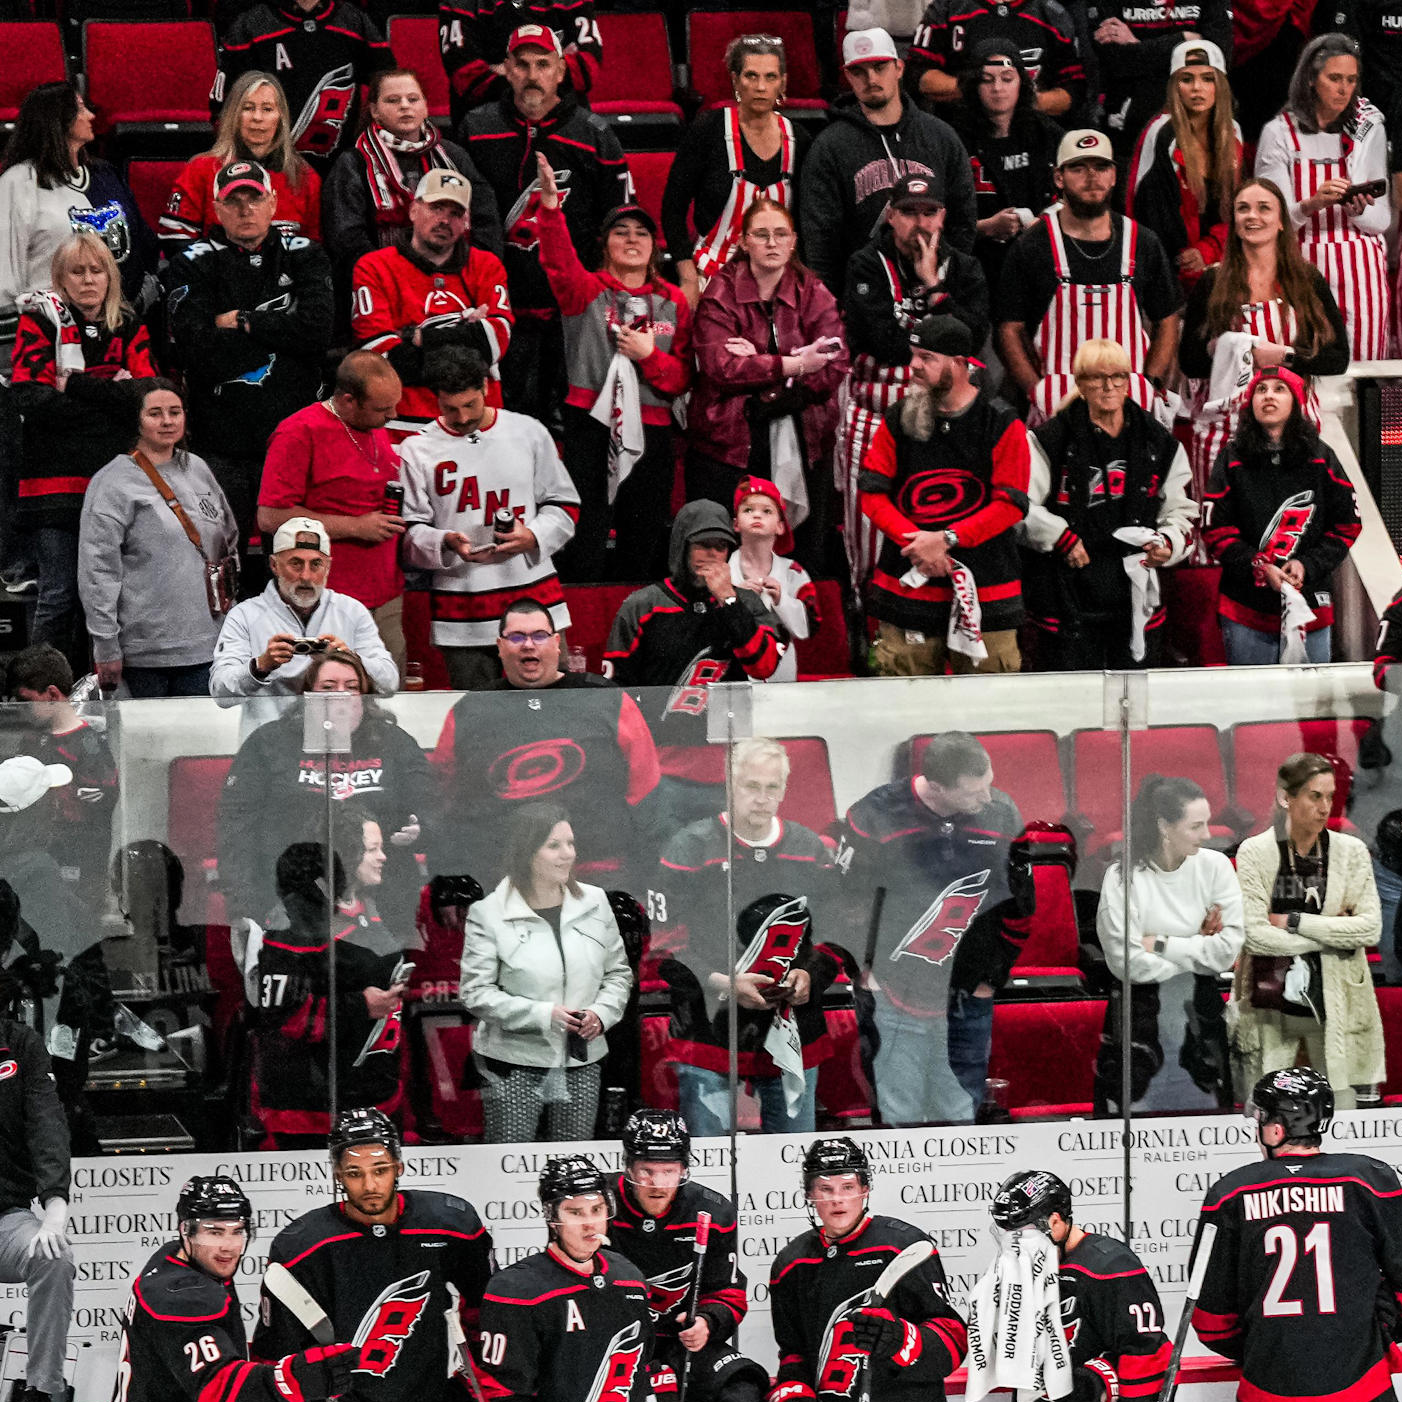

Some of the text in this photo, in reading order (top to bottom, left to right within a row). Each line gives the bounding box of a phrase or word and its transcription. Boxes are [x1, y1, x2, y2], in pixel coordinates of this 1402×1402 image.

[275, 43, 293, 71] A
[495, 284, 509, 310] 2
[260, 973, 288, 1008] 37
[780, 1135, 1016, 1164] CARNIA CLOSETS
[1198, 1124, 1261, 1147] CLOS
[215, 1156, 459, 1183] CALIFORN SETS
[690, 1148, 738, 1168] SETS
[868, 1161, 933, 1175] RALEIGH
[1143, 1149, 1208, 1163] RALEIGH
[73, 1165, 171, 1189] CLOSETS
[900, 1182, 1000, 1204] CALIFOR
[1243, 1186, 1345, 1221] NIKISHIN
[65, 1211, 179, 1236] ALIFORNI
[928, 1228, 979, 1249] SETS
[727, 1252, 739, 1284] 2
[1262, 1221, 1338, 1317] 21
[565, 1299, 587, 1333] A
[1005, 1283, 1023, 1361] BODYARMOR
[1128, 1302, 1163, 1333] 22
[183, 1334, 222, 1373] 26
[480, 1330, 508, 1366] 20
